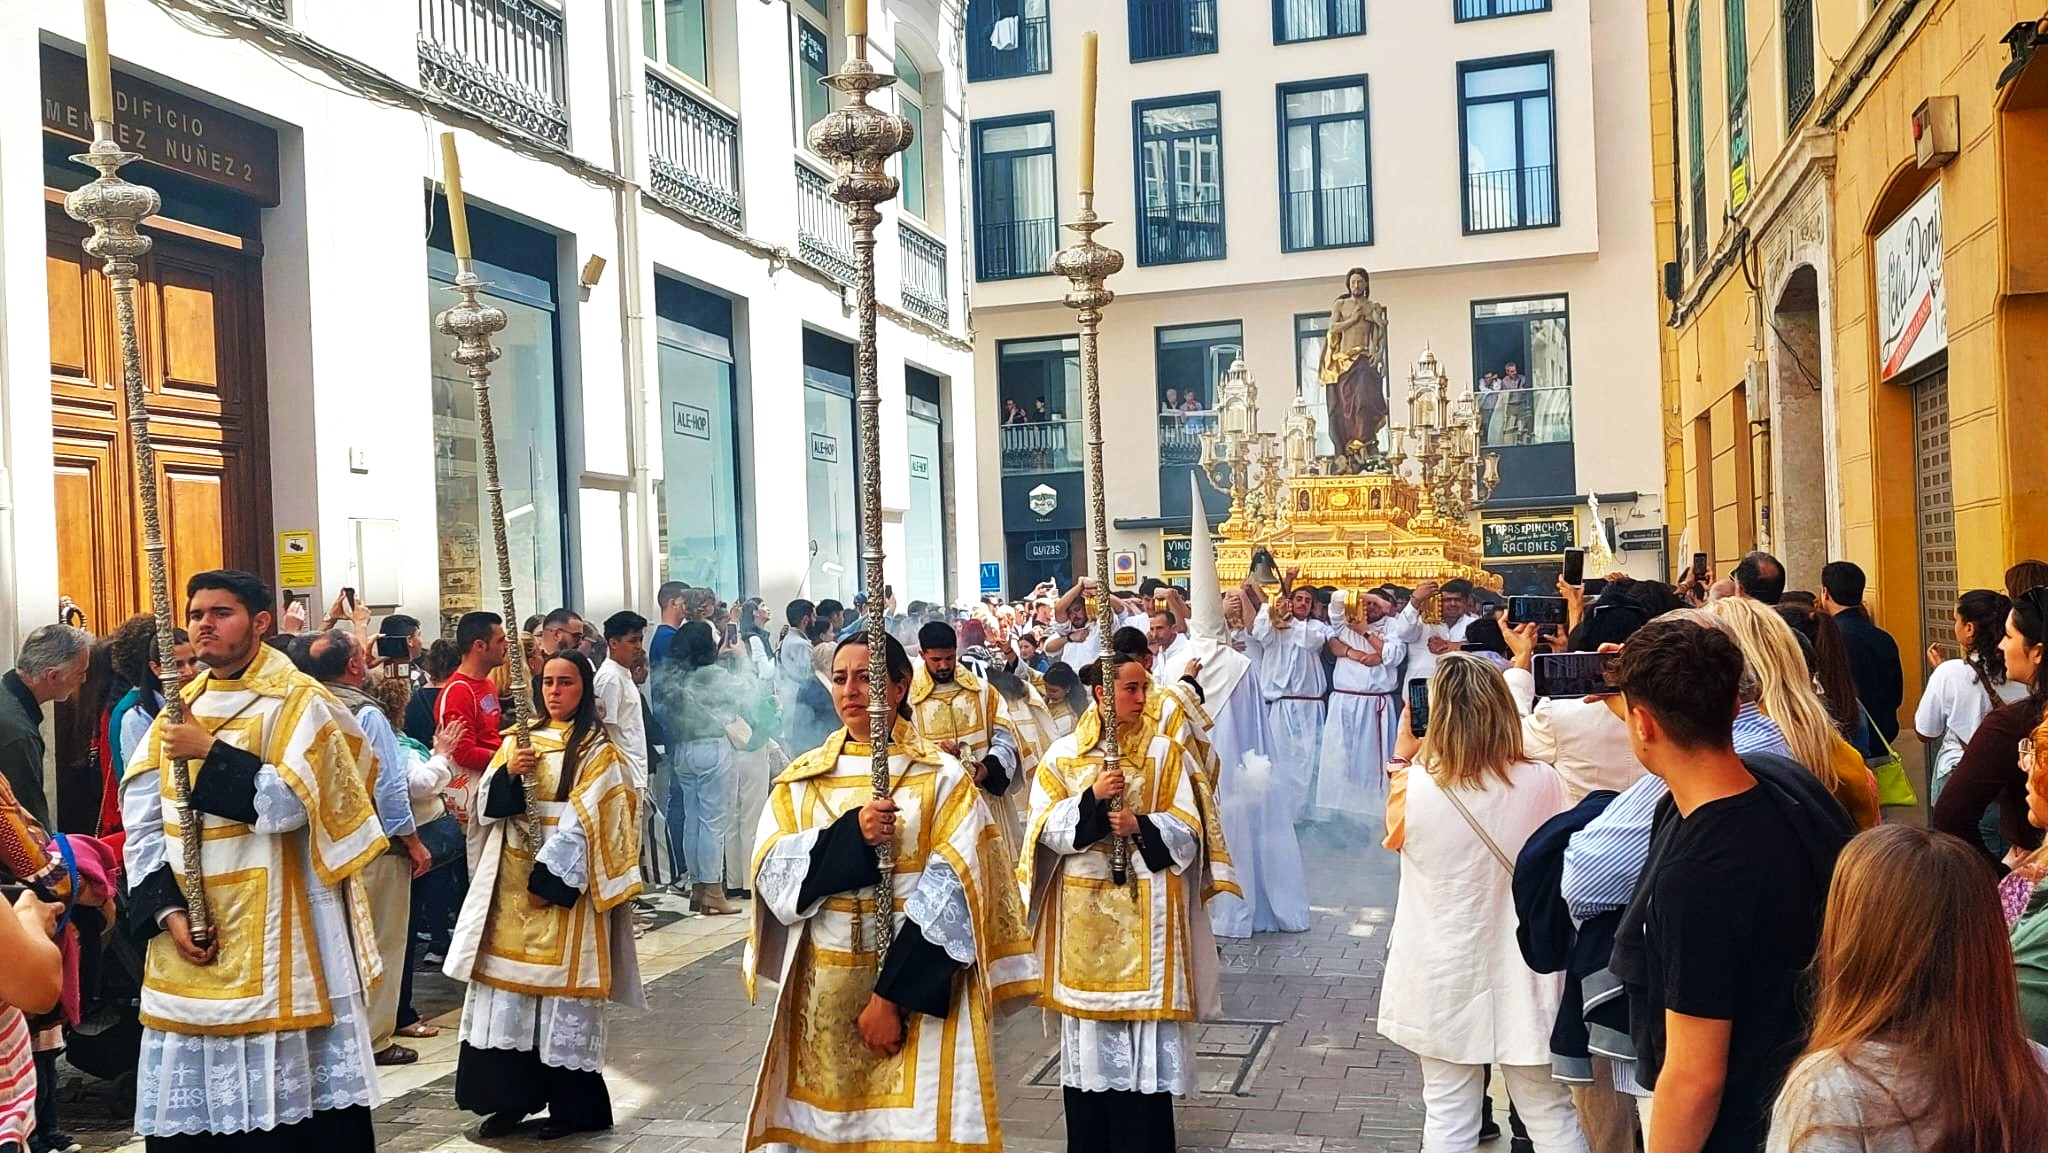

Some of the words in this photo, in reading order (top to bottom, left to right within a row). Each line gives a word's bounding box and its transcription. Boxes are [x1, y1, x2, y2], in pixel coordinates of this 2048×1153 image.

[116, 91, 204, 137] DIFICIO
[45, 98, 147, 150] MENEZ
[165, 137, 235, 177] NUÑEZ
[244, 163, 253, 182] 2
[677, 411, 707, 431] ALE-HOP
[814, 440, 835, 456] ALE-HOP
[1488, 523, 1521, 536] TAPAS
[1525, 521, 1569, 535] PINCHOS
[1502, 540, 1558, 554] RACIONES
